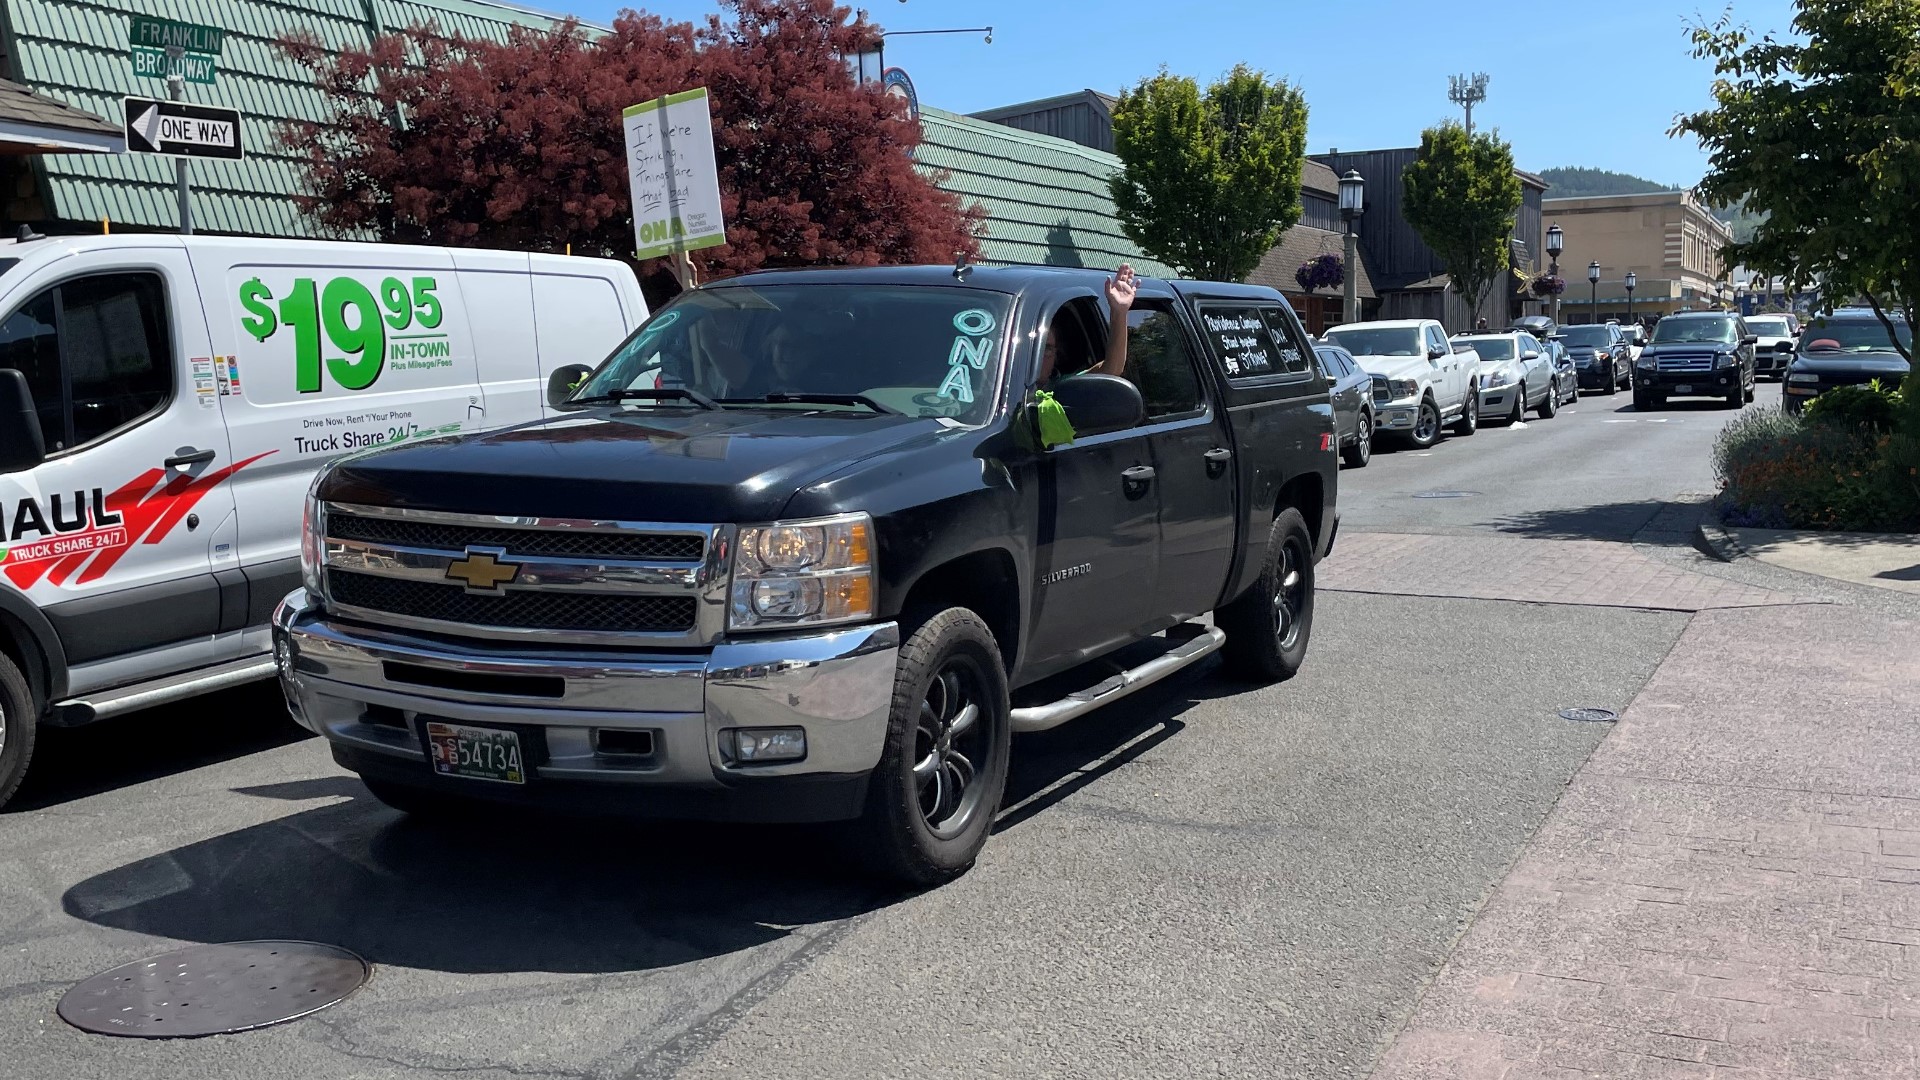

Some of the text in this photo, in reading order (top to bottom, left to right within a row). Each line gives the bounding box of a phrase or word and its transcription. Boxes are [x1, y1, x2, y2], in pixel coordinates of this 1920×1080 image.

[140, 22, 220, 51] FRANKLIN
[136, 51, 212, 81] BROADWAY
[161, 118, 229, 144] ONE WAY
[632, 123, 692, 148] If we're
[675, 167, 694, 178] are
[639, 216, 688, 244] ONA
[390, 341, 451, 361] IN-TOWN
[937, 307, 997, 403] ONA
[390, 359, 453, 371] Plus Mileage/Fees
[303, 419, 324, 429] Drive
[325, 417, 346, 427] Now,
[347, 415, 365, 425] Rent
[390, 411, 412, 420] Phone
[294, 432, 339, 454] Truck
[343, 429, 385, 450] Share
[10, 530, 121, 562] TRUCK SHARE 24/7
[1041, 562, 1092, 586] SILVERADO
[458, 739, 519, 772] 54734
